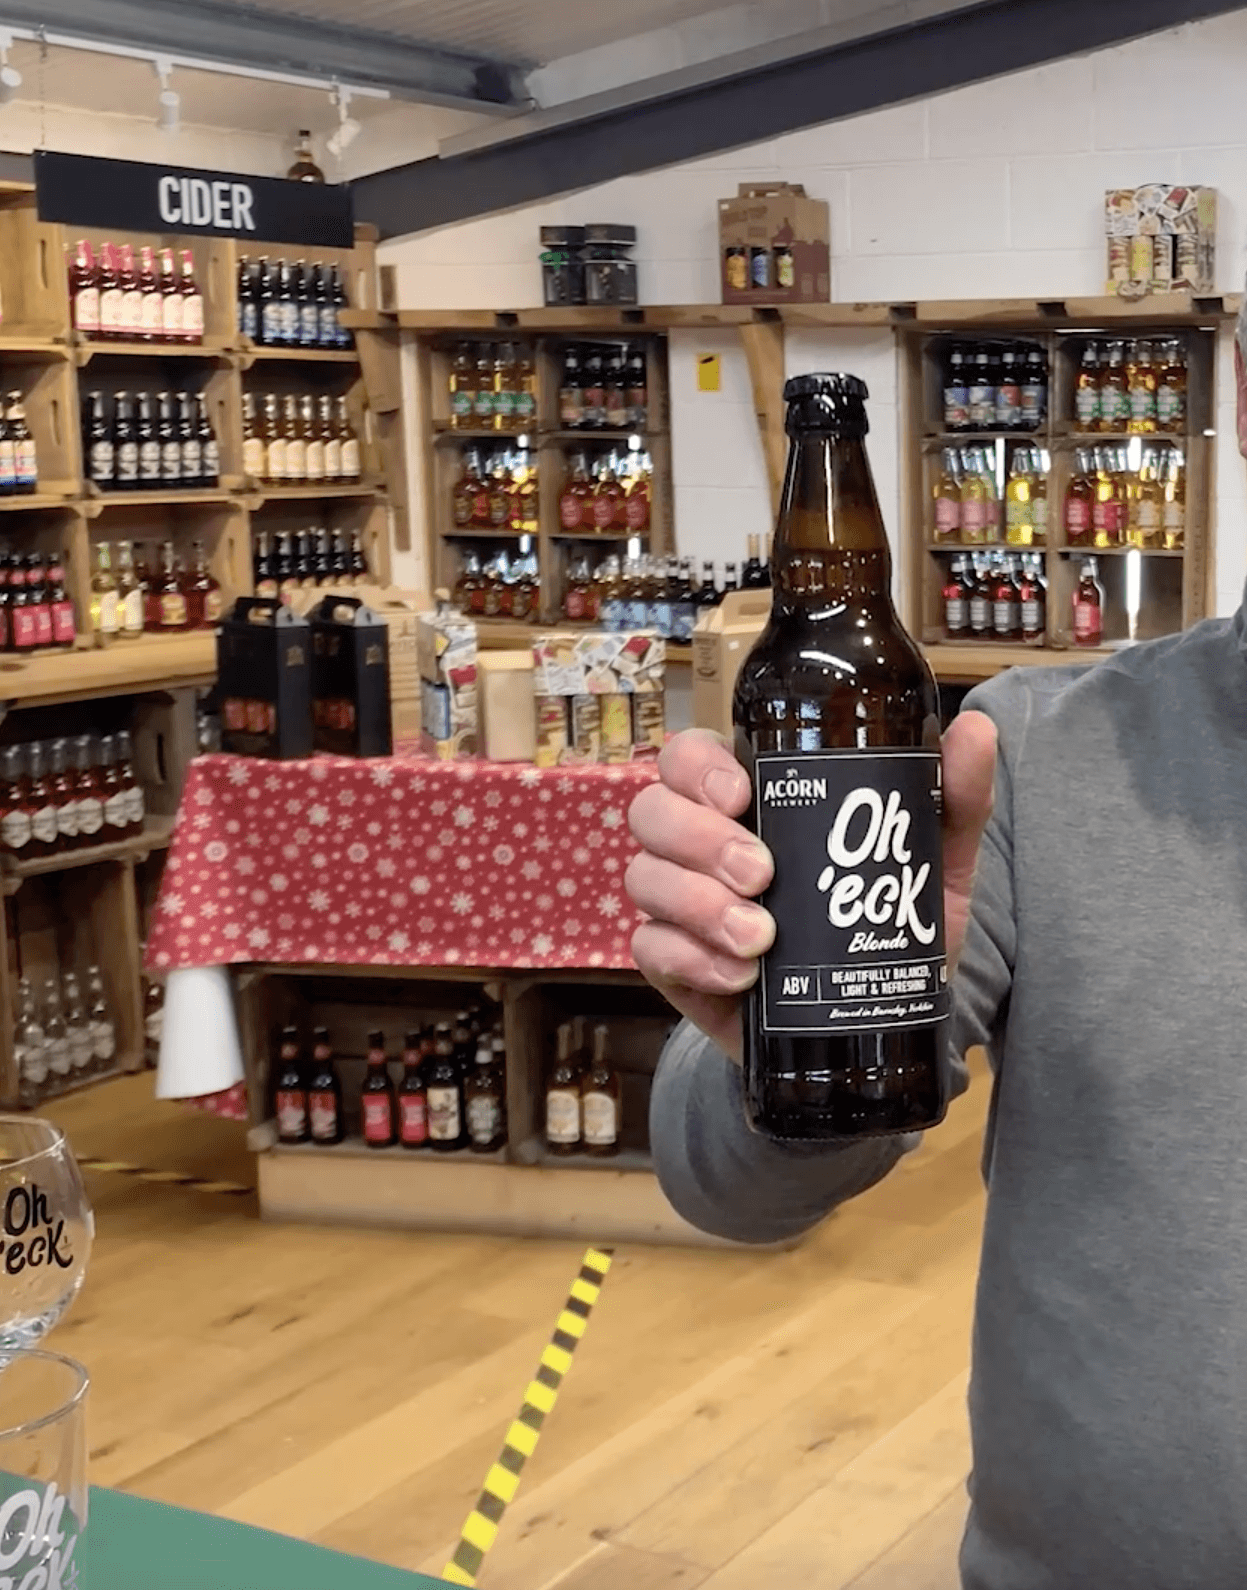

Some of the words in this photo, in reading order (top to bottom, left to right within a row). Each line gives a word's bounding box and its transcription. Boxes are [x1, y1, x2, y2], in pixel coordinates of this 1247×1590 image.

[158, 176, 256, 231] CIDER
[764, 778, 827, 801] ACORN
[827, 787, 912, 868] Oh
[848, 929, 910, 954] Blonde
[782, 976, 810, 995] ABV
[831, 967, 891, 984] BEAUTIFULLY
[841, 982, 867, 997] LIGHT
[870, 982, 880, 995] &
[4, 1183, 53, 1236] Oh
[0, 1481, 66, 1572] Oh
